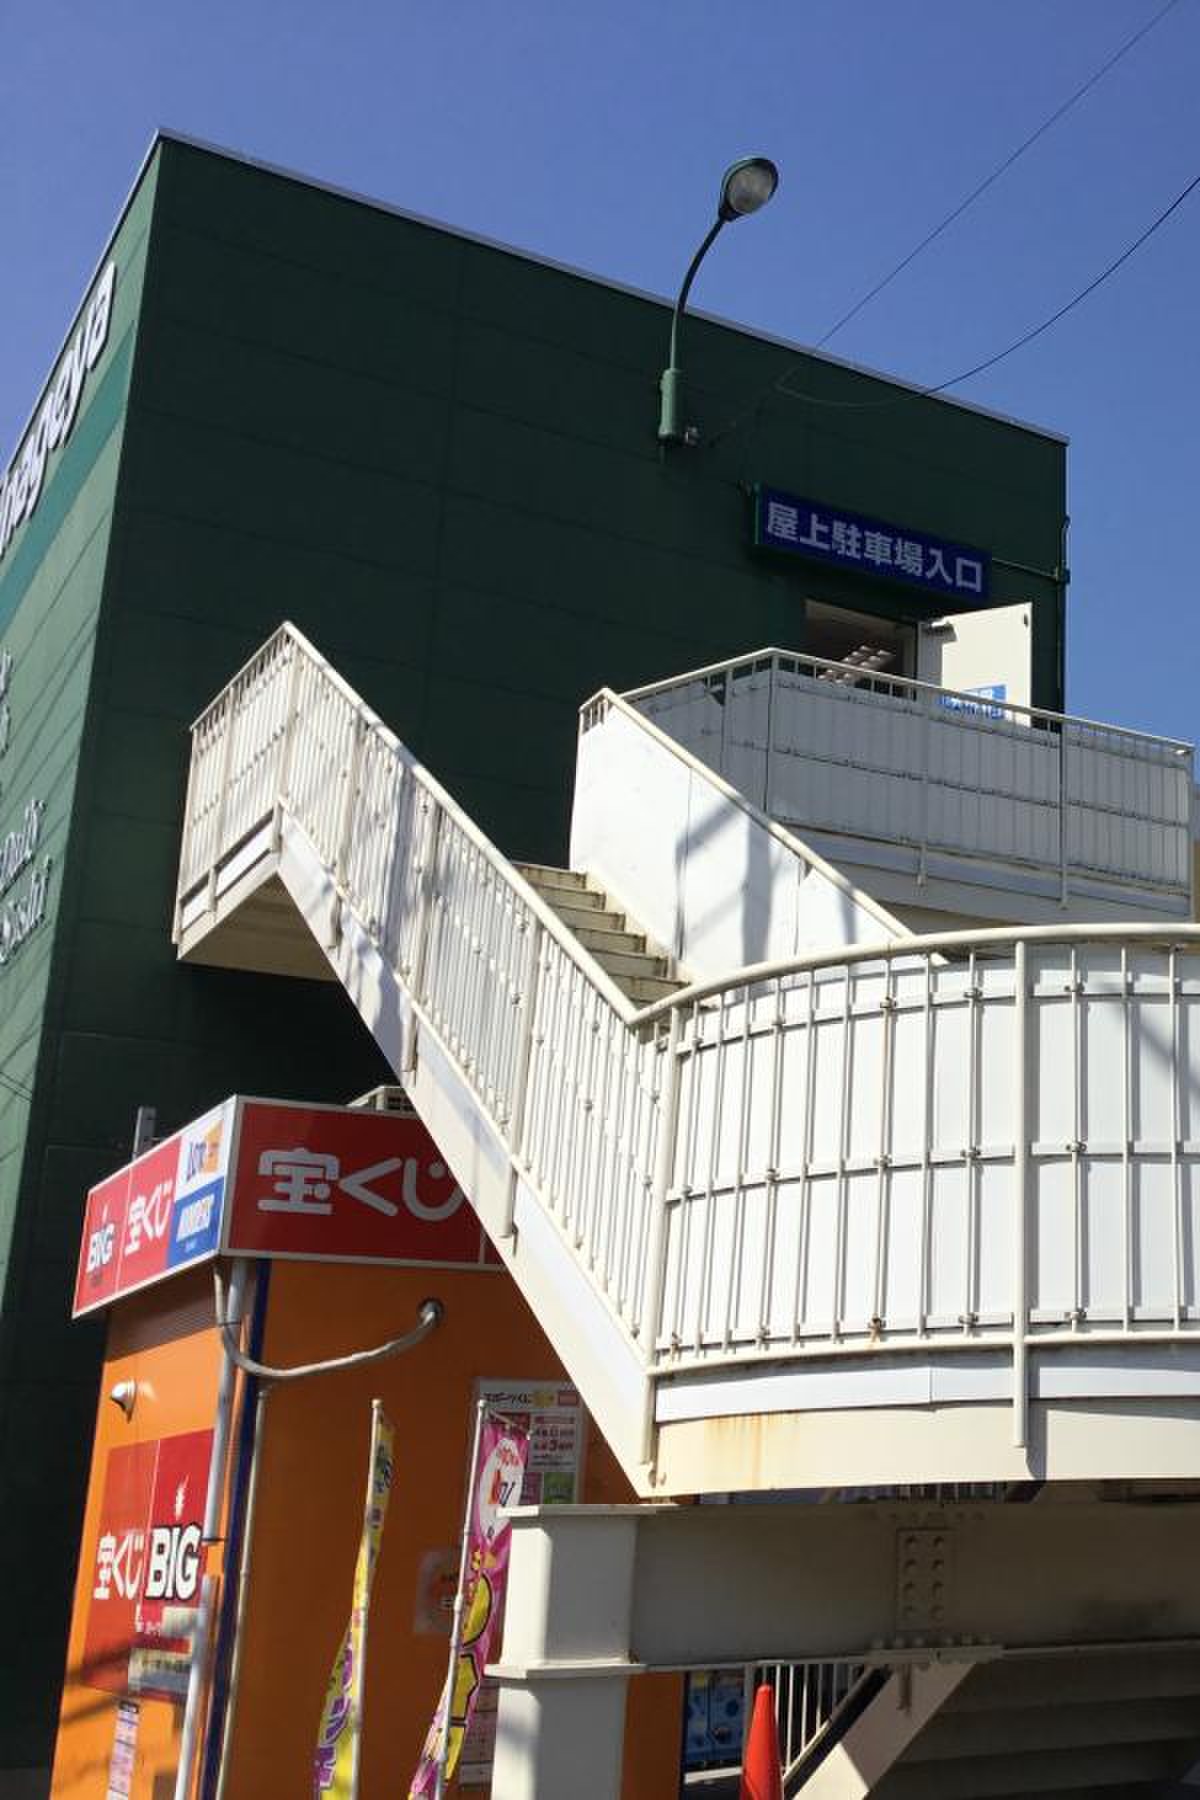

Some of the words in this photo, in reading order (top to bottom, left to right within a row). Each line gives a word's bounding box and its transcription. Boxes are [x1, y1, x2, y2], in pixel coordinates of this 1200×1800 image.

[0, 260, 116, 555] nageya
[767, 501, 983, 593] 屋上駐車場入口
[124, 1179, 174, 1257] 宝くじ
[257, 1147, 466, 1221] 宝くじ
[85, 1222, 116, 1274] BIG
[94, 1530, 145, 1600] 宝くじ
[145, 1522, 202, 1601] BIG
